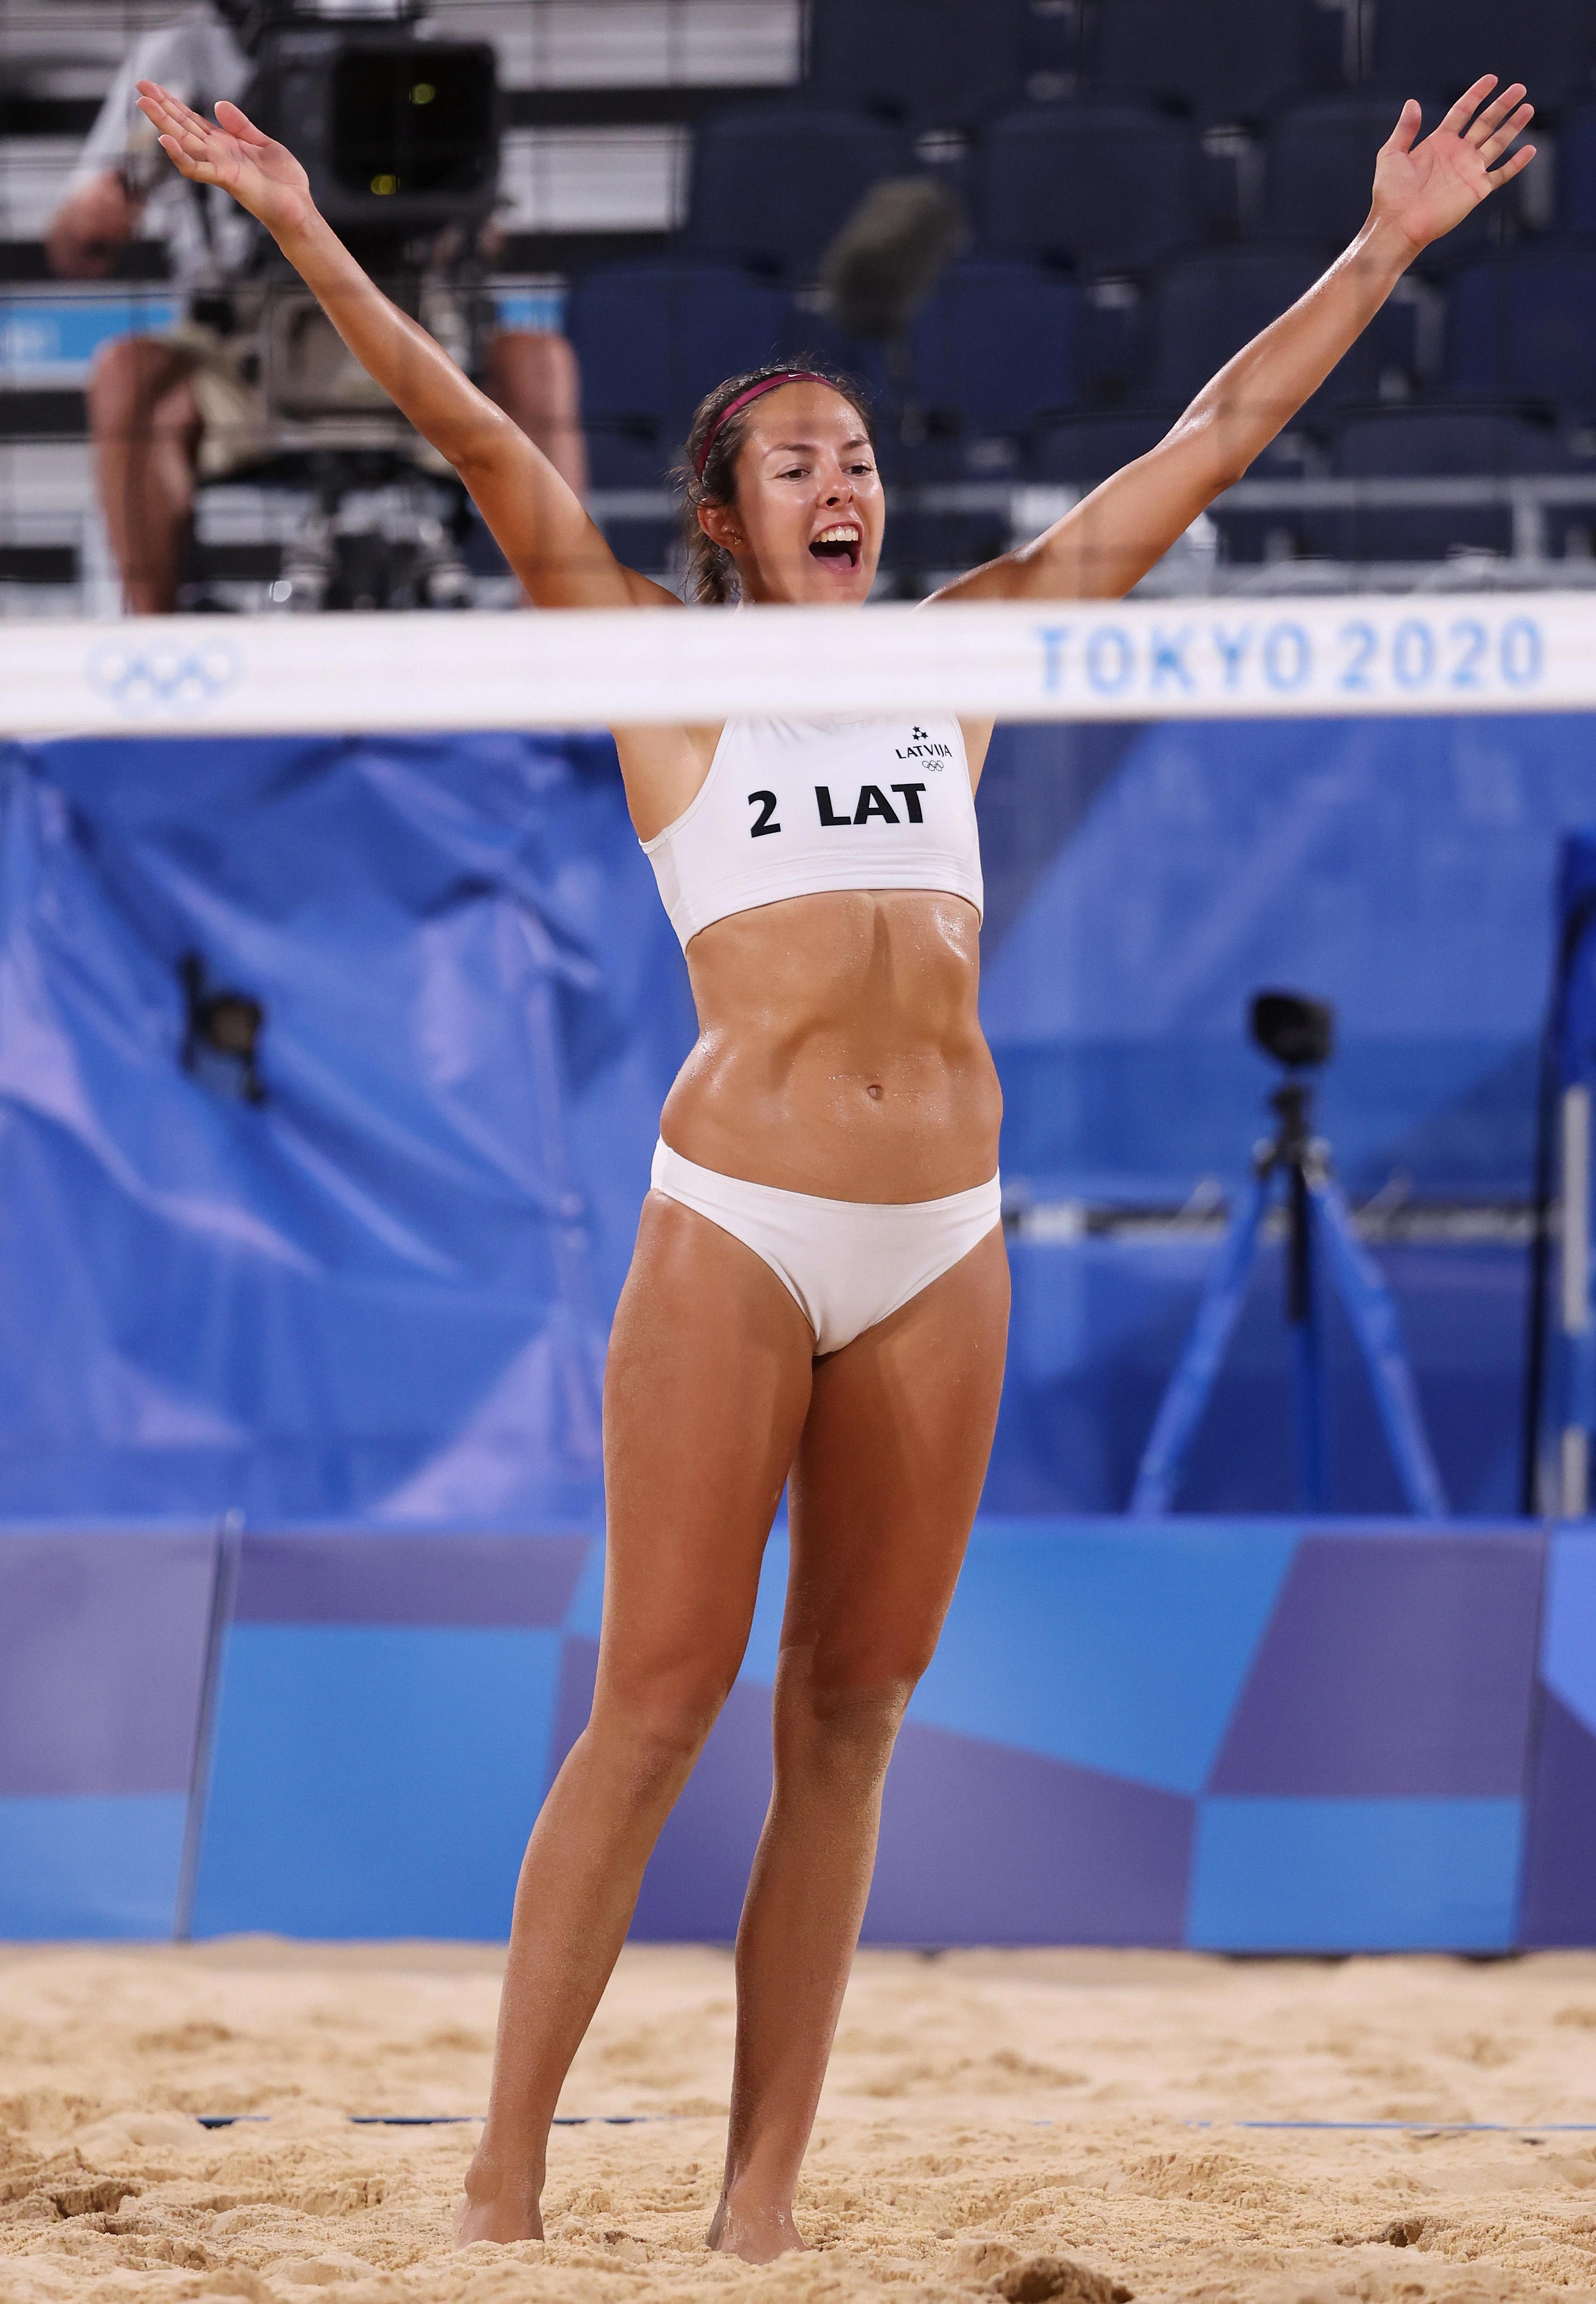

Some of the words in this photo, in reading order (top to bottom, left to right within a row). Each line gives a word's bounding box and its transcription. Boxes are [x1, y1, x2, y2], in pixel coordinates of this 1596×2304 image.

[1035, 622, 1311, 693] TOKYO
[1339, 616, 1544, 690] 2020
[895, 744, 952, 759] LATVIJA
[748, 790, 781, 838] 2
[815, 783, 926, 826] LAT
